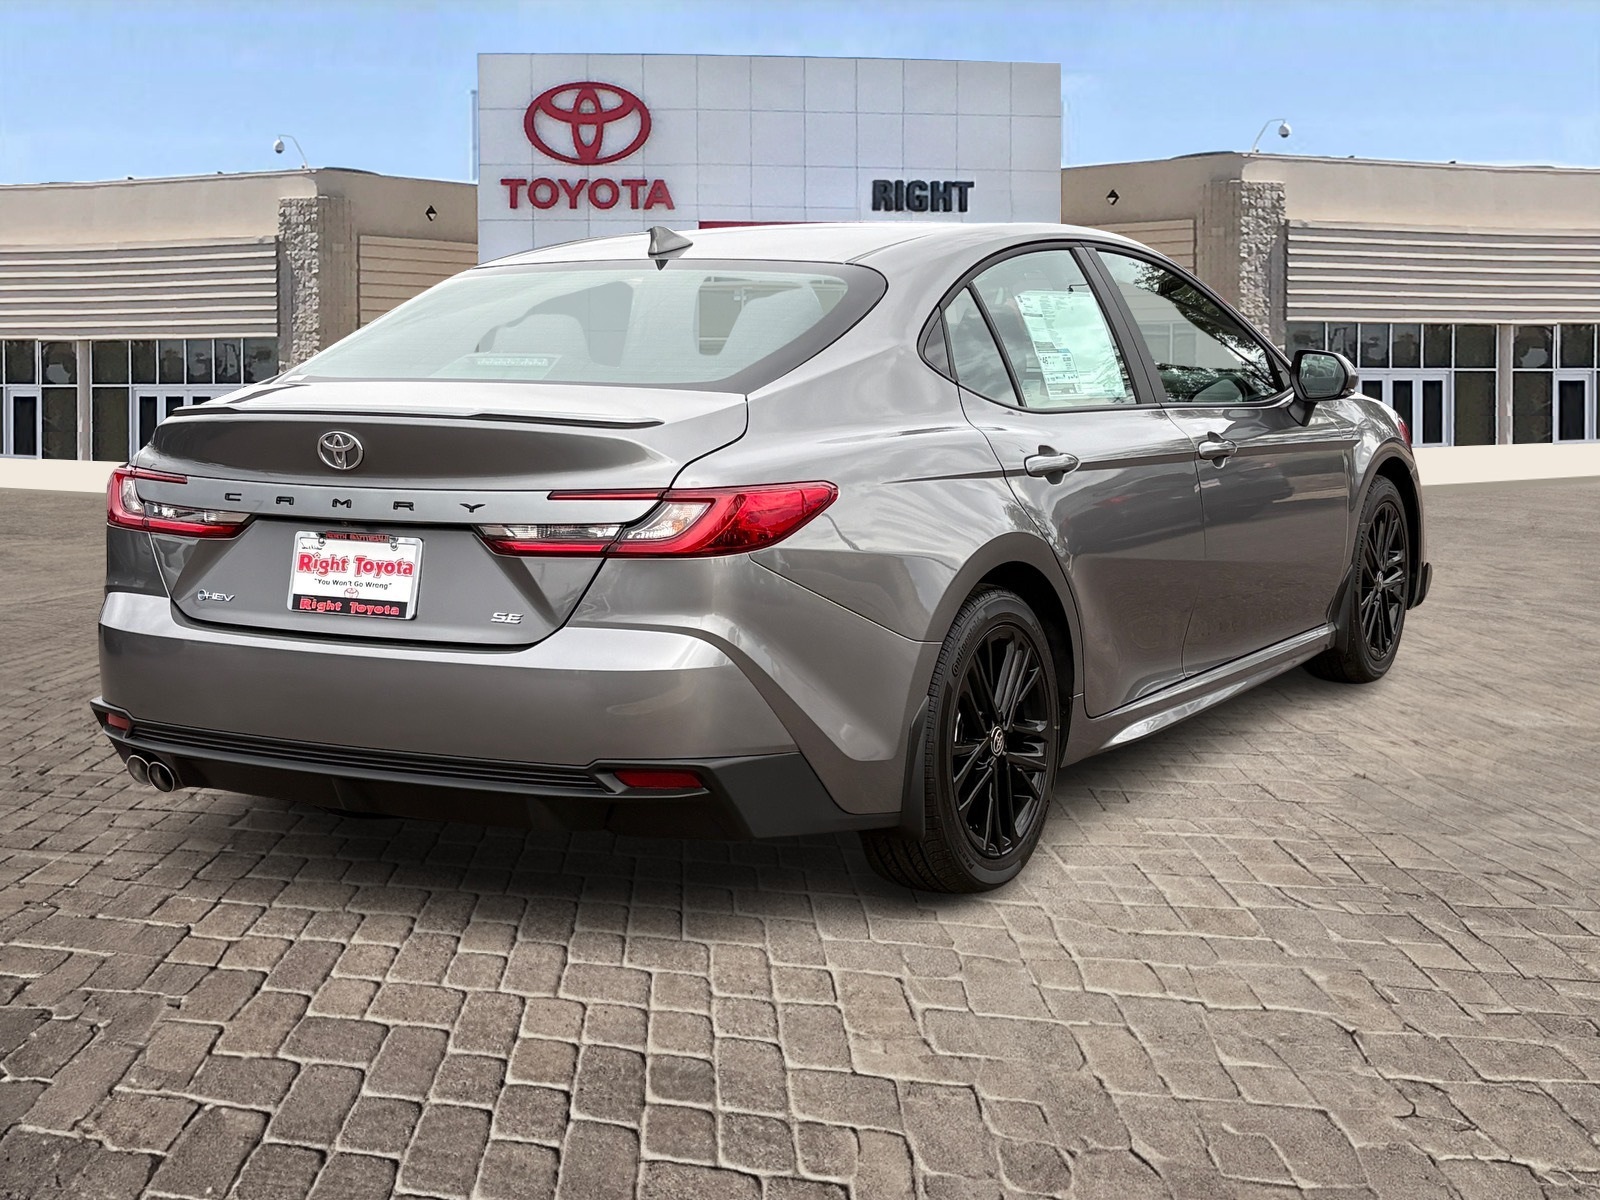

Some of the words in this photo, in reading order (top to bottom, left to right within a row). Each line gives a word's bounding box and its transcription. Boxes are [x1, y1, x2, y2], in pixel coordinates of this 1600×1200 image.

[501, 178, 675, 210] TOYOTA
[872, 179, 975, 214] RIGHT
[224, 492, 486, 514] CAMRY
[297, 552, 350, 577] Right
[354, 555, 416, 578] Toyota
[332, 579, 353, 587] Won't
[300, 597, 343, 613] Right
[349, 601, 400, 615] Toyota
[490, 611, 524, 625] SE
